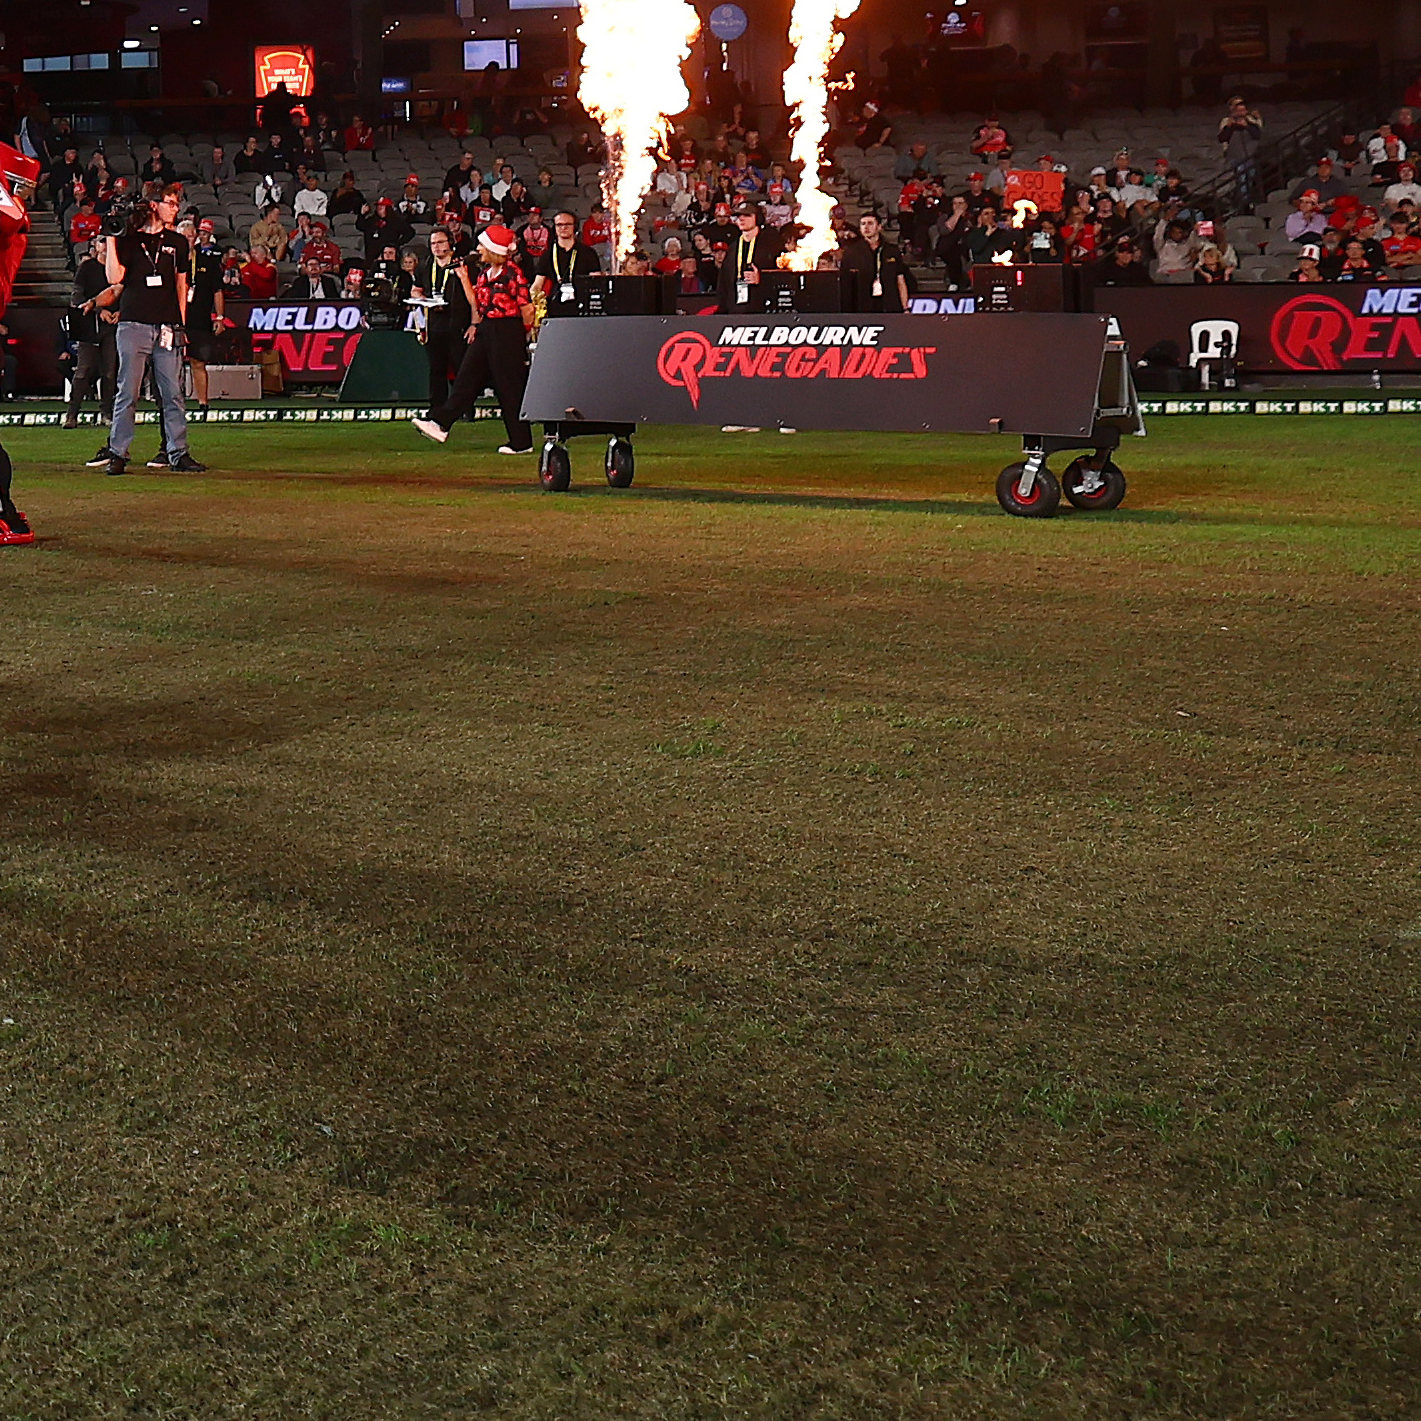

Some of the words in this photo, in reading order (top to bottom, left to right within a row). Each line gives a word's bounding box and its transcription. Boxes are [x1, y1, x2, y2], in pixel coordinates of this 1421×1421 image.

[1023, 172, 1046, 190] GO
[248, 306, 361, 331] MELBO
[717, 326, 885, 345] MELBOURNE
[657, 330, 937, 411] RENEGADES
[395, 407, 430, 420] BKT
[1137, 401, 1163, 414] KT
[1165, 401, 1206, 414] BKT
[1208, 401, 1249, 414] BKT
[1255, 401, 1296, 414] BKT
[1299, 400, 1339, 414] BKT
[1342, 400, 1384, 413] BKT
[24, 413, 59, 425] BKT
[206, 410, 241, 423] BKT
[243, 409, 279, 422] BKT
